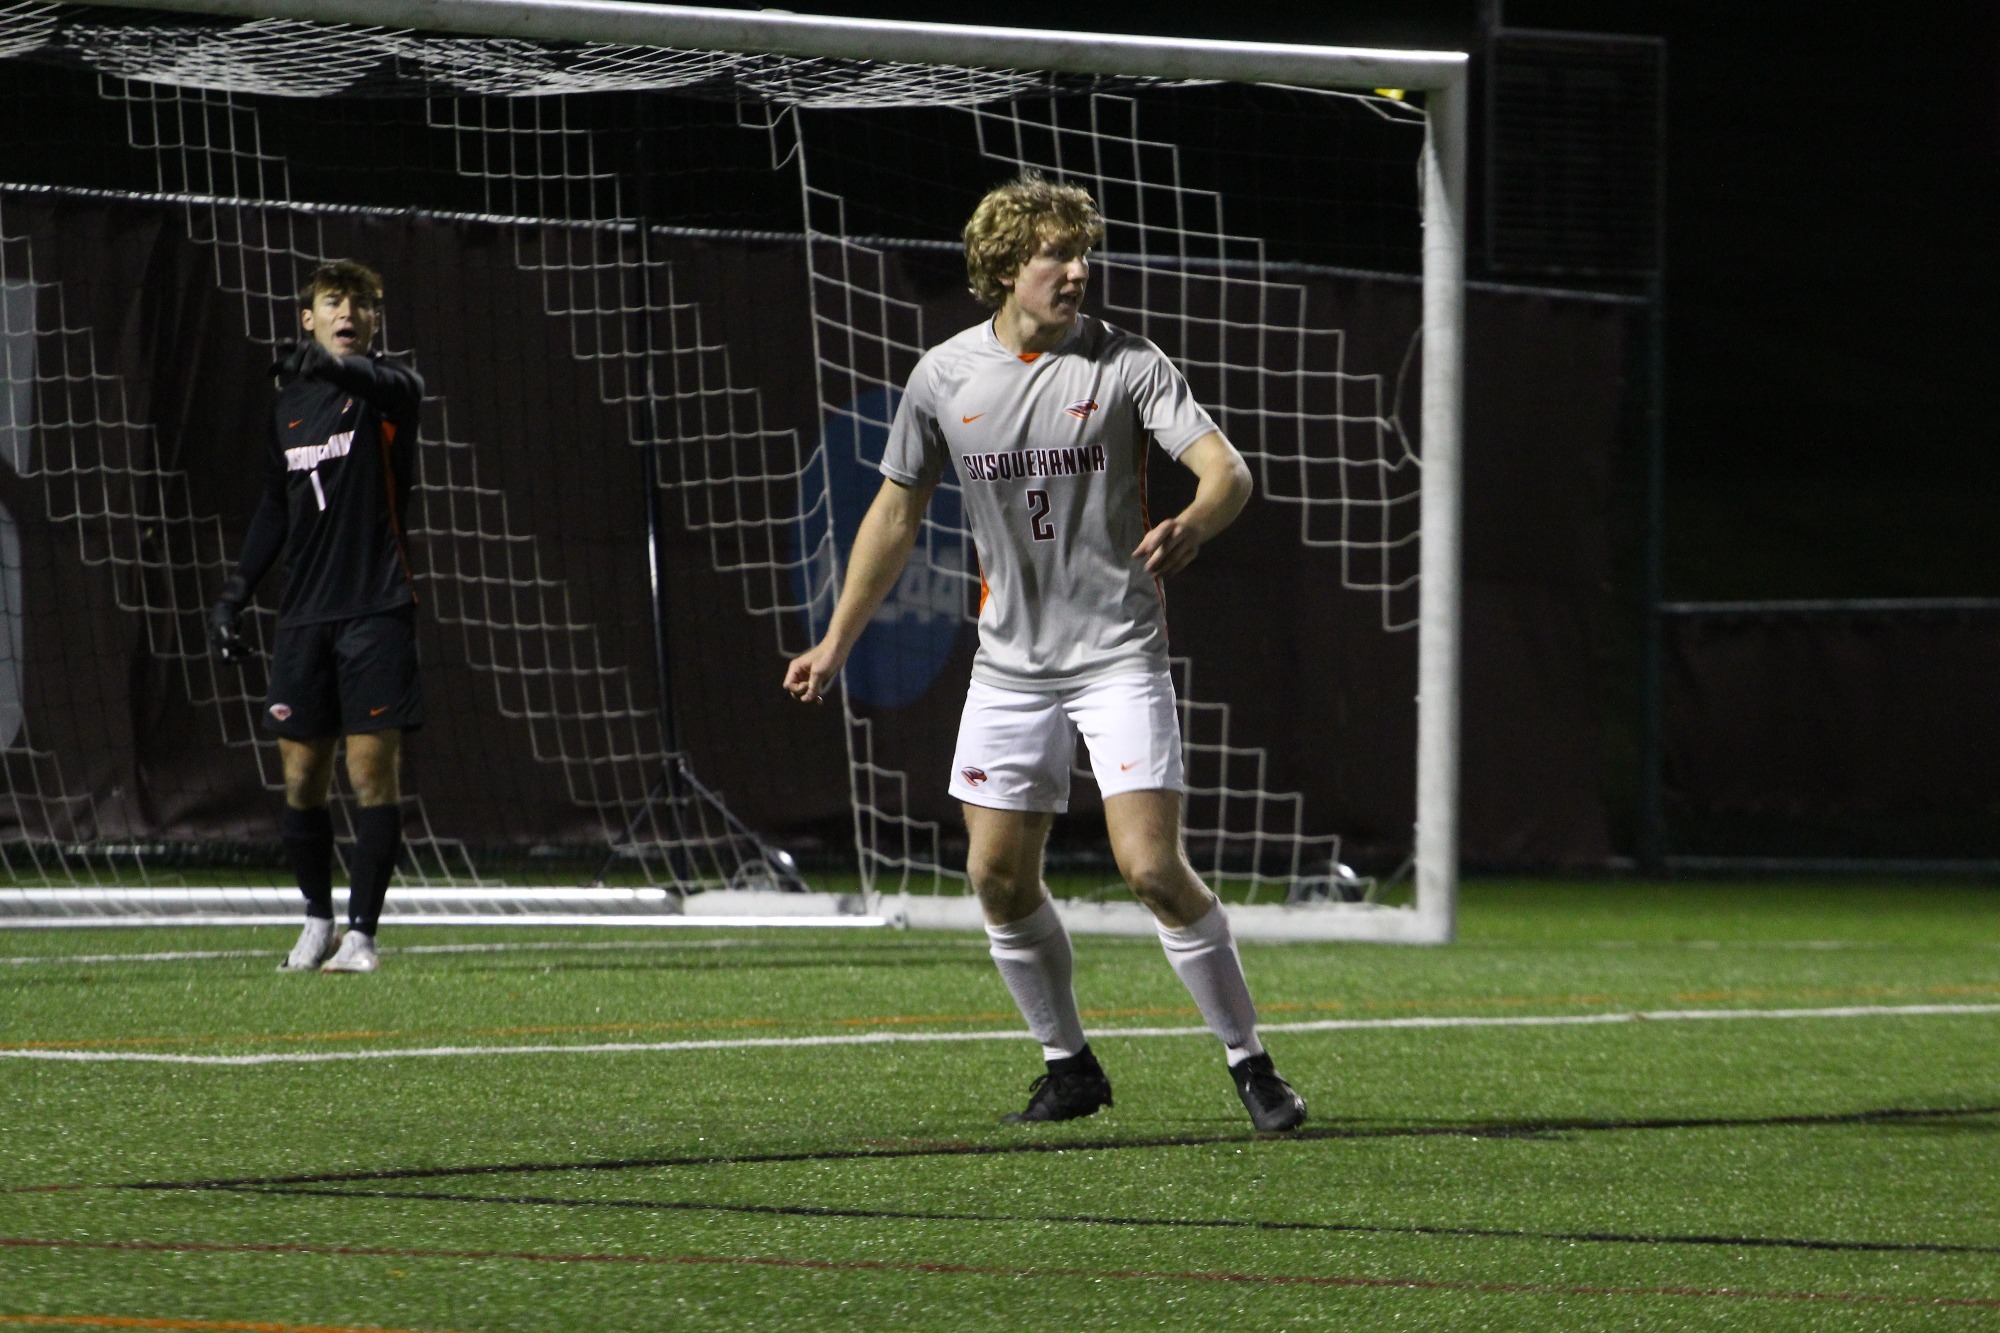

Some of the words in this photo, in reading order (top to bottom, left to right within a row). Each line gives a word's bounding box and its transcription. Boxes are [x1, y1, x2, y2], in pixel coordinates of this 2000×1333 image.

[962, 444, 1106, 483] SUSQUEHANNA
[310, 470, 326, 511] 1
[1025, 488, 1056, 542] 2
